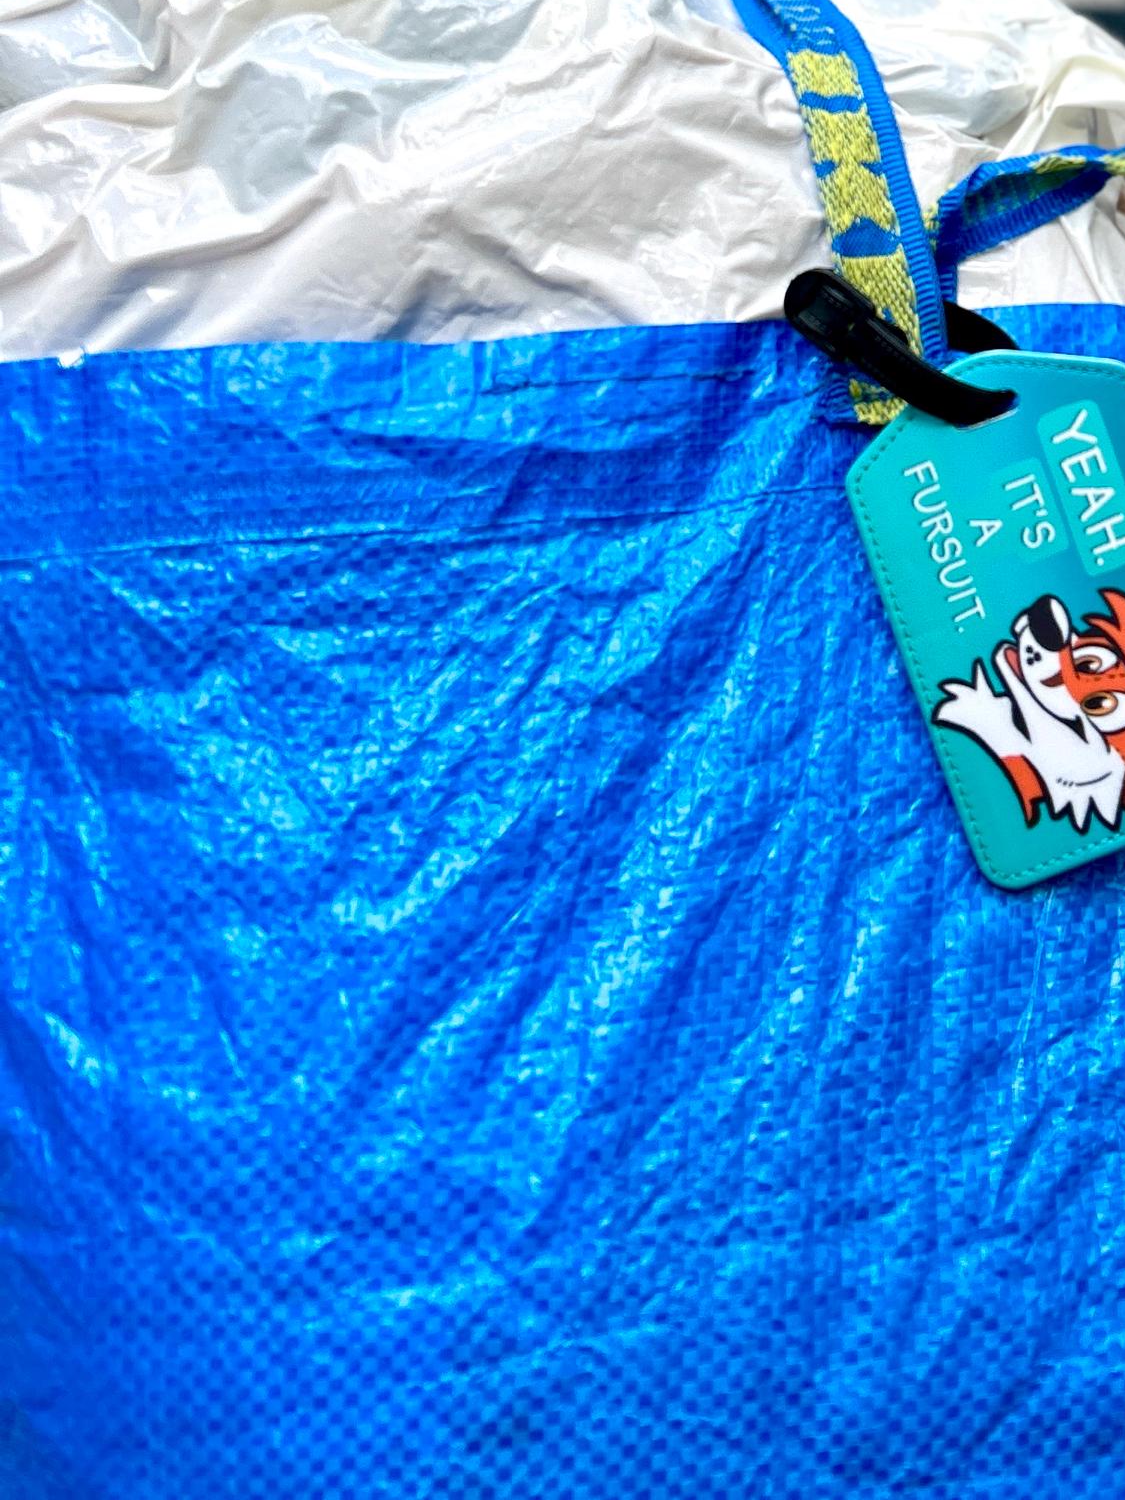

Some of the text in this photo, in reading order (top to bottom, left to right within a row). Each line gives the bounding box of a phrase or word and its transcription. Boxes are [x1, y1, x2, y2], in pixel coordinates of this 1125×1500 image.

[903, 460, 986, 634] FURSUIT.
[968, 518, 1004, 548] A
[1003, 473, 1057, 550] IT'S
